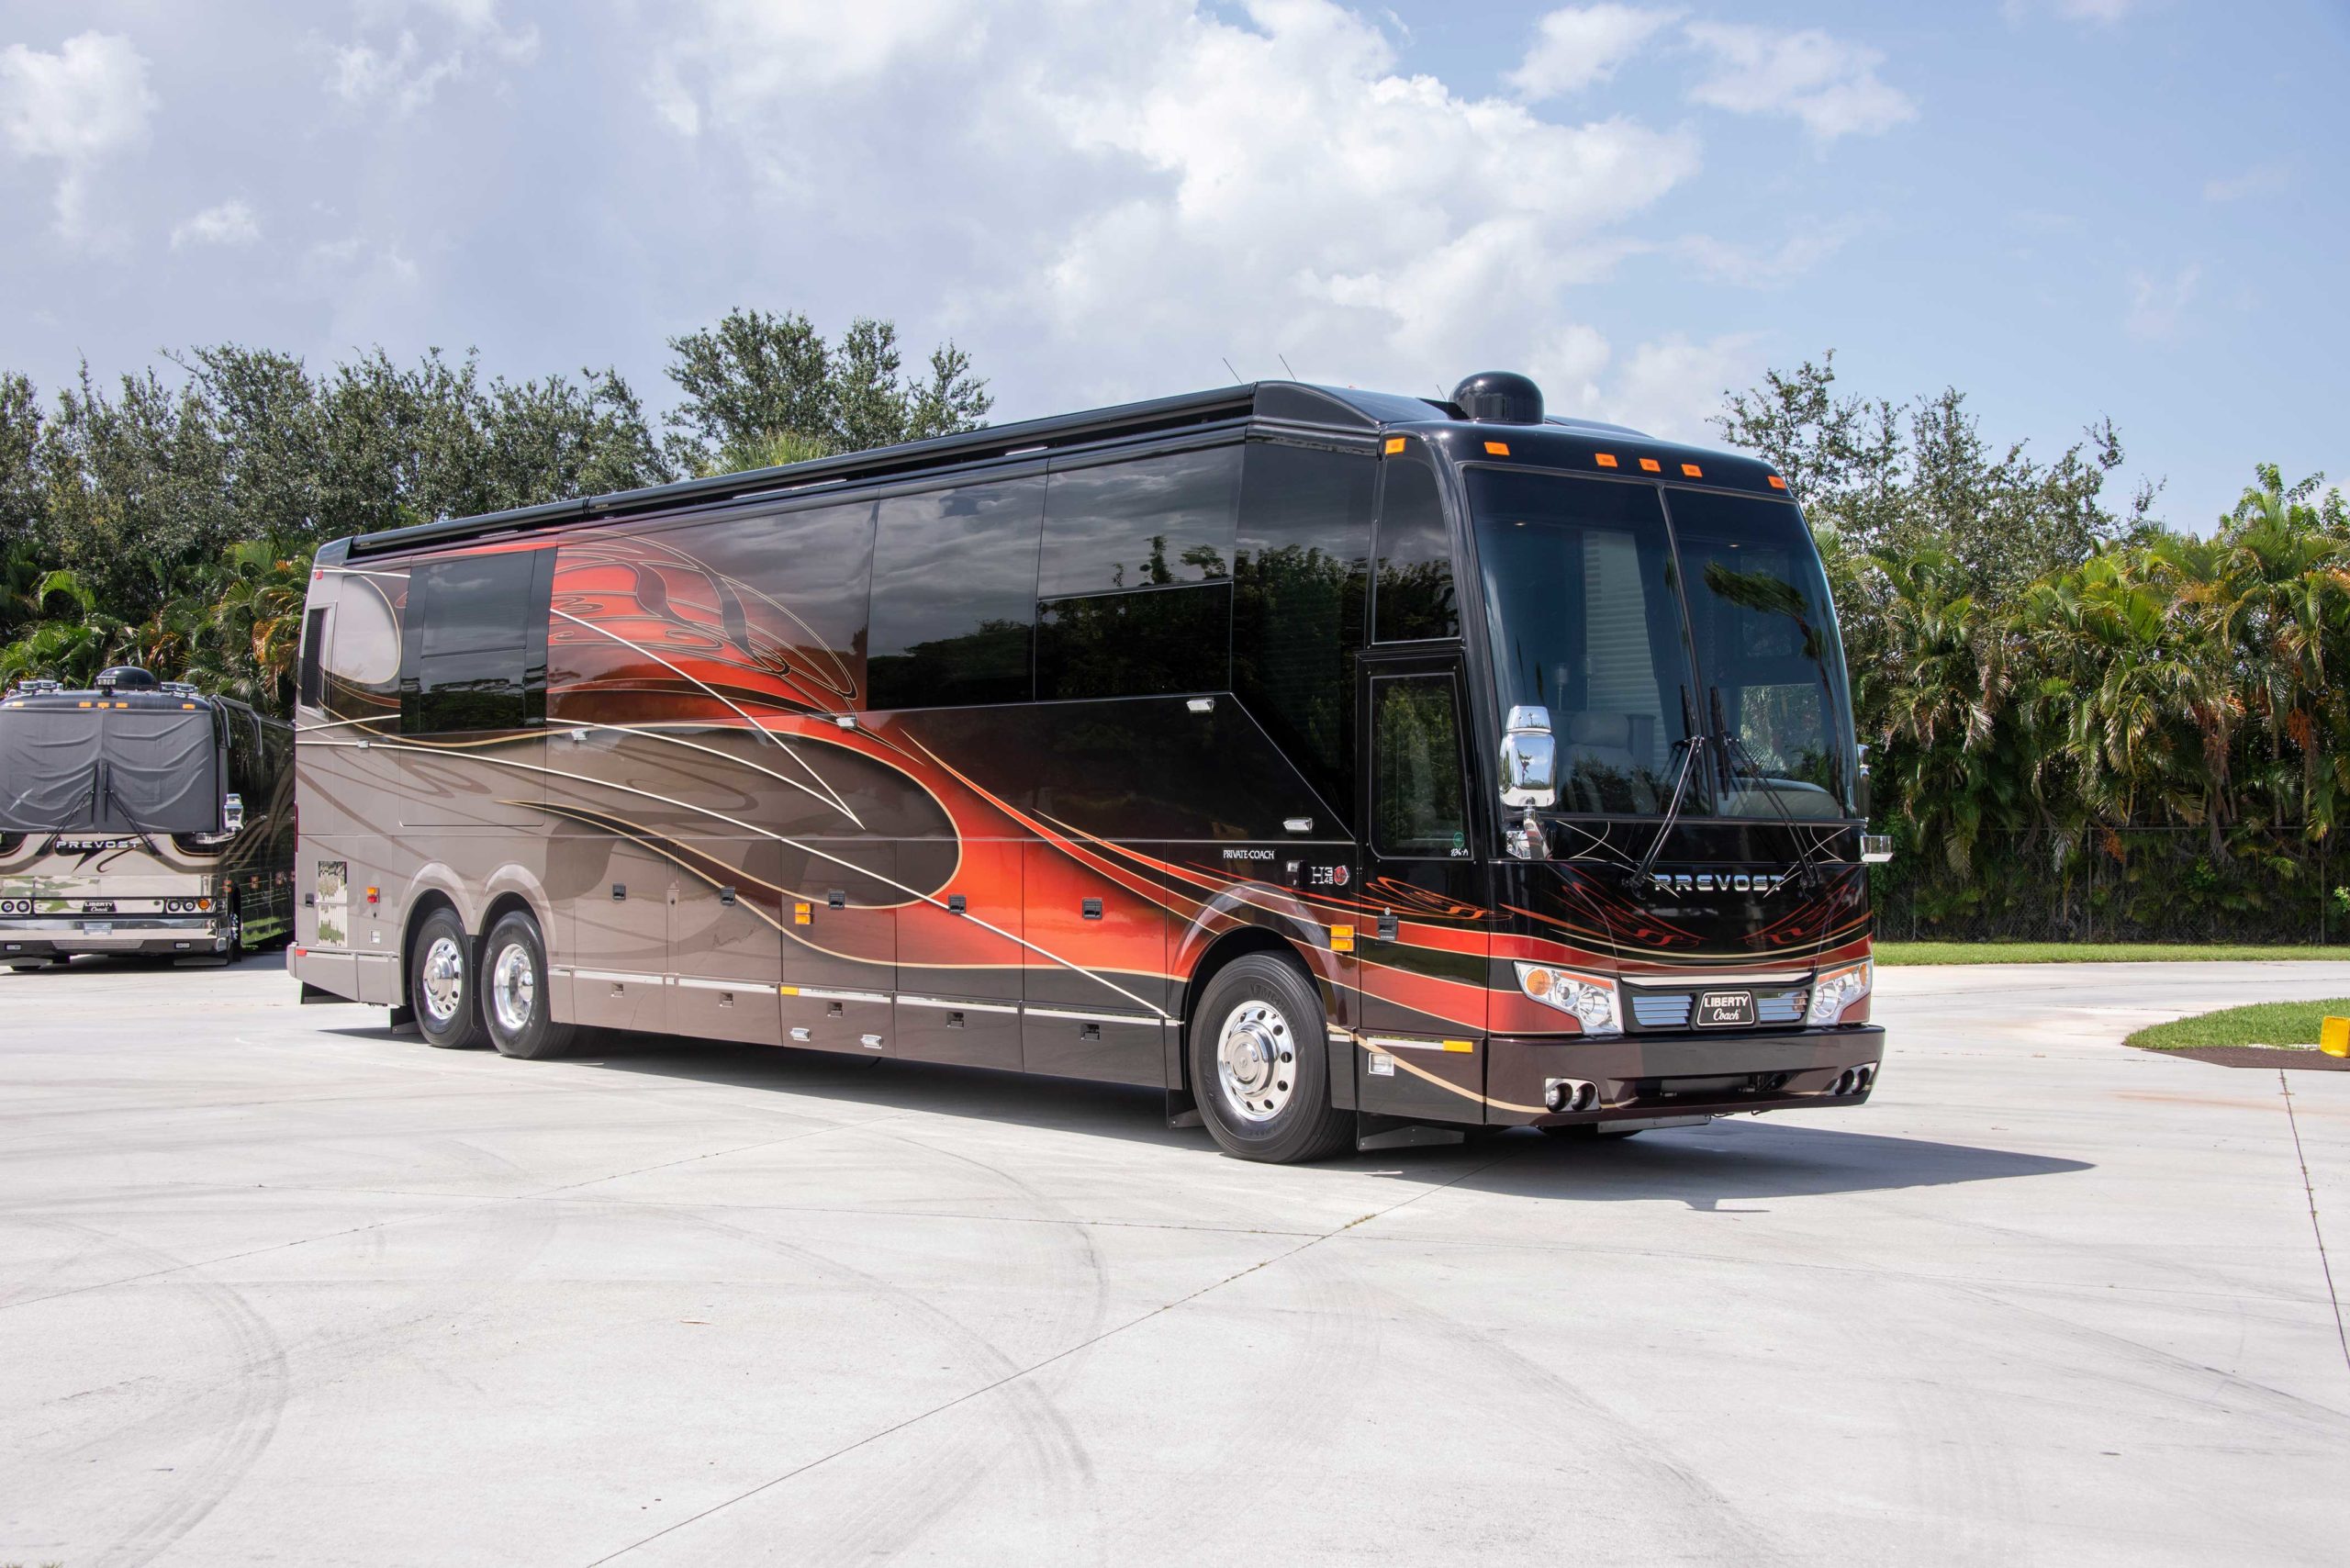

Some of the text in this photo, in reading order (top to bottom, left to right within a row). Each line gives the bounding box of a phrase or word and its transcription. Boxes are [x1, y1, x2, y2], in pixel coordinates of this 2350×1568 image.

[1223, 849, 1275, 859] PRIVATE COACH
[1654, 874, 1785, 891] PREVOST
[1704, 996, 1749, 1007] LIBERTY
[1713, 1007, 1740, 1021] Coach
